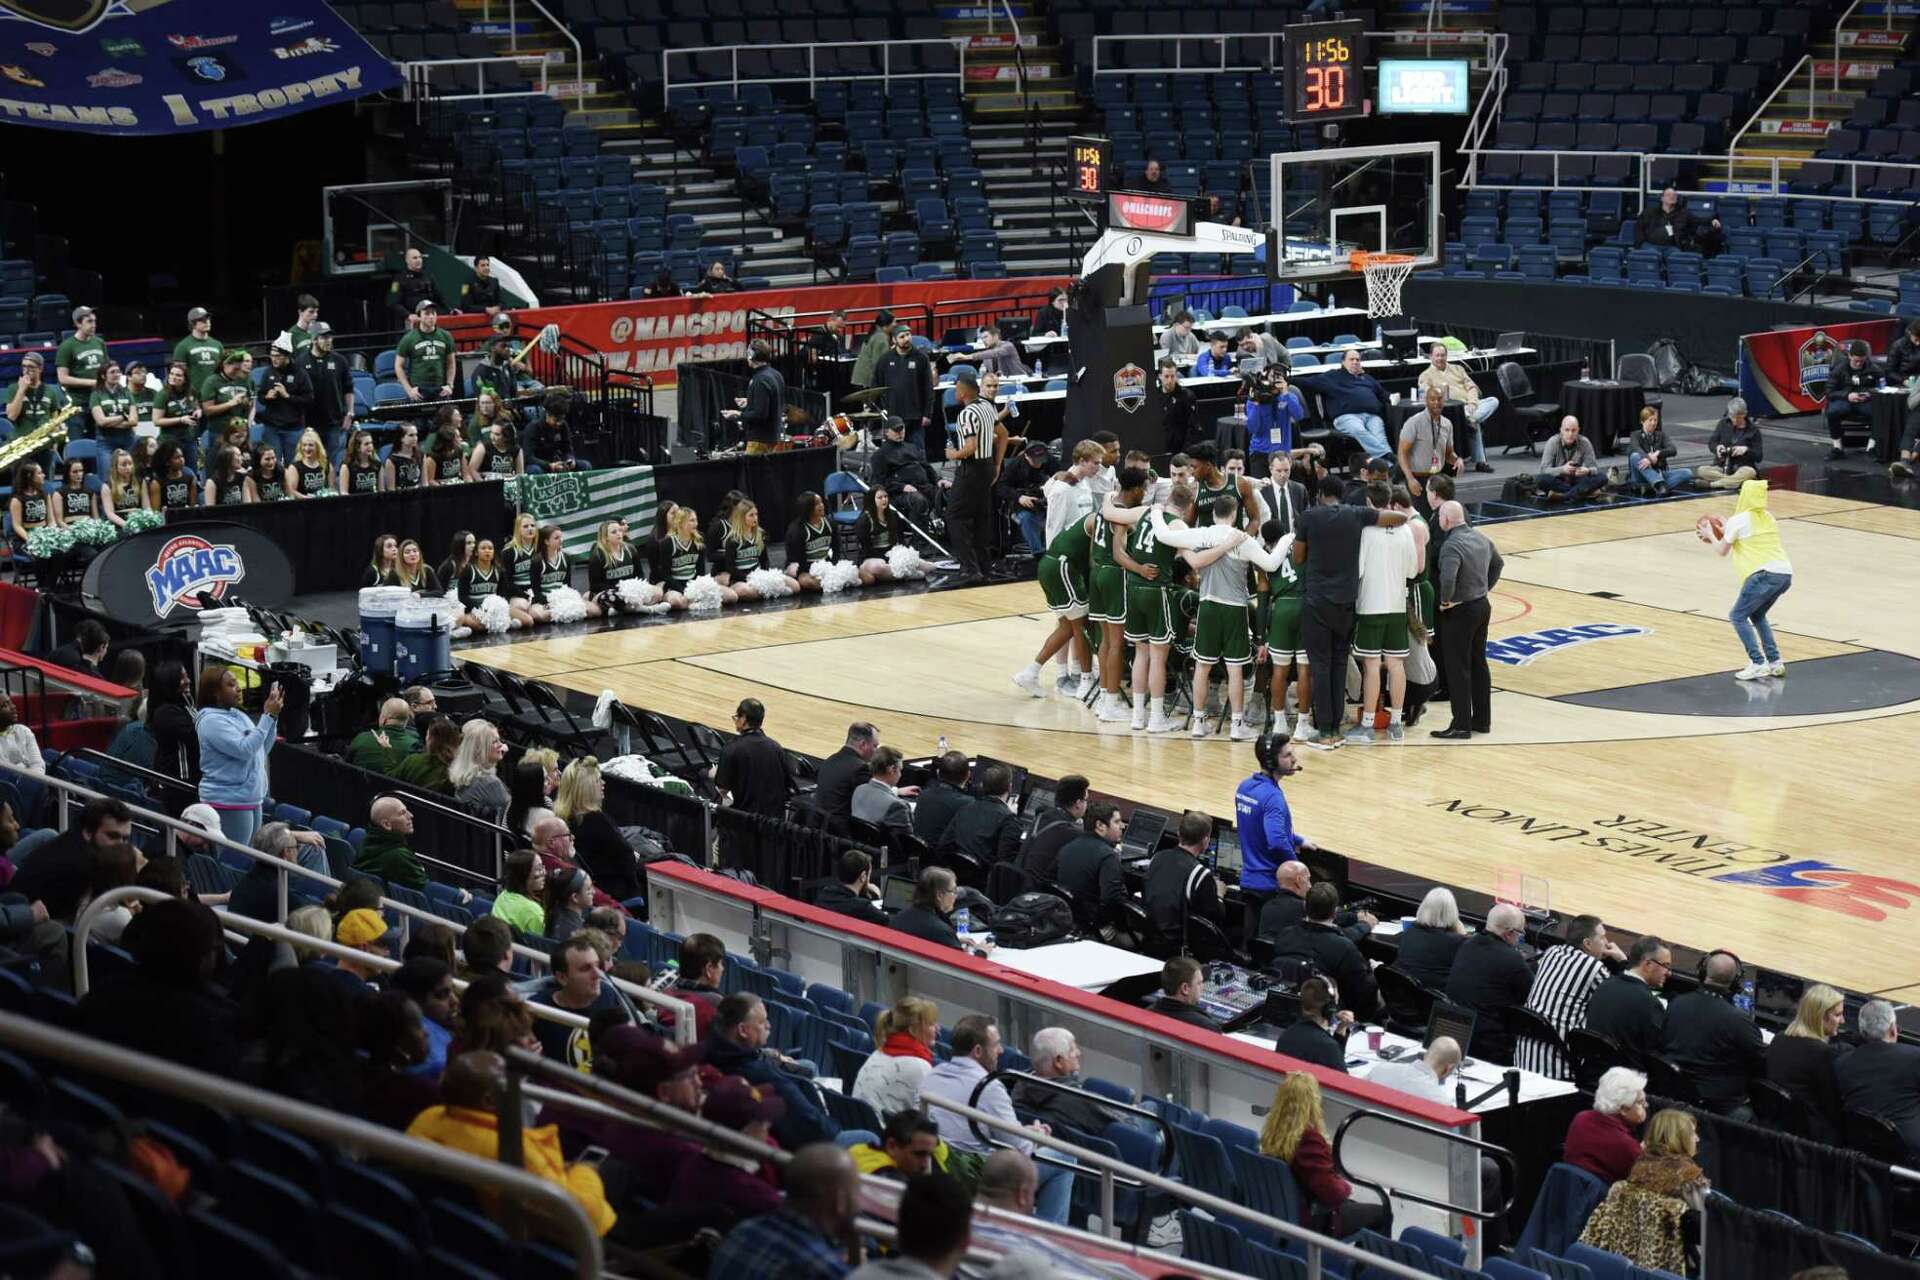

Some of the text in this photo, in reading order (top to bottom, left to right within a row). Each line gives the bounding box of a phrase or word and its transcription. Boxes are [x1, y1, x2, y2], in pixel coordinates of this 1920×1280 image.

[1305, 38, 1349, 63] 11:56
[0, 98, 138, 126] TEAMS
[200, 66, 362, 119] TROPHY
[1306, 66, 1344, 111] 30
[1081, 166, 1097, 190] 30
[1221, 229, 1257, 246] SPALDING
[1135, 520, 1155, 553] 14
[150, 548, 238, 610] MAAC
[1281, 557, 1298, 583] 4
[1426, 798, 1729, 877] TIMES UNION
[1592, 813, 1791, 864] CENTER
